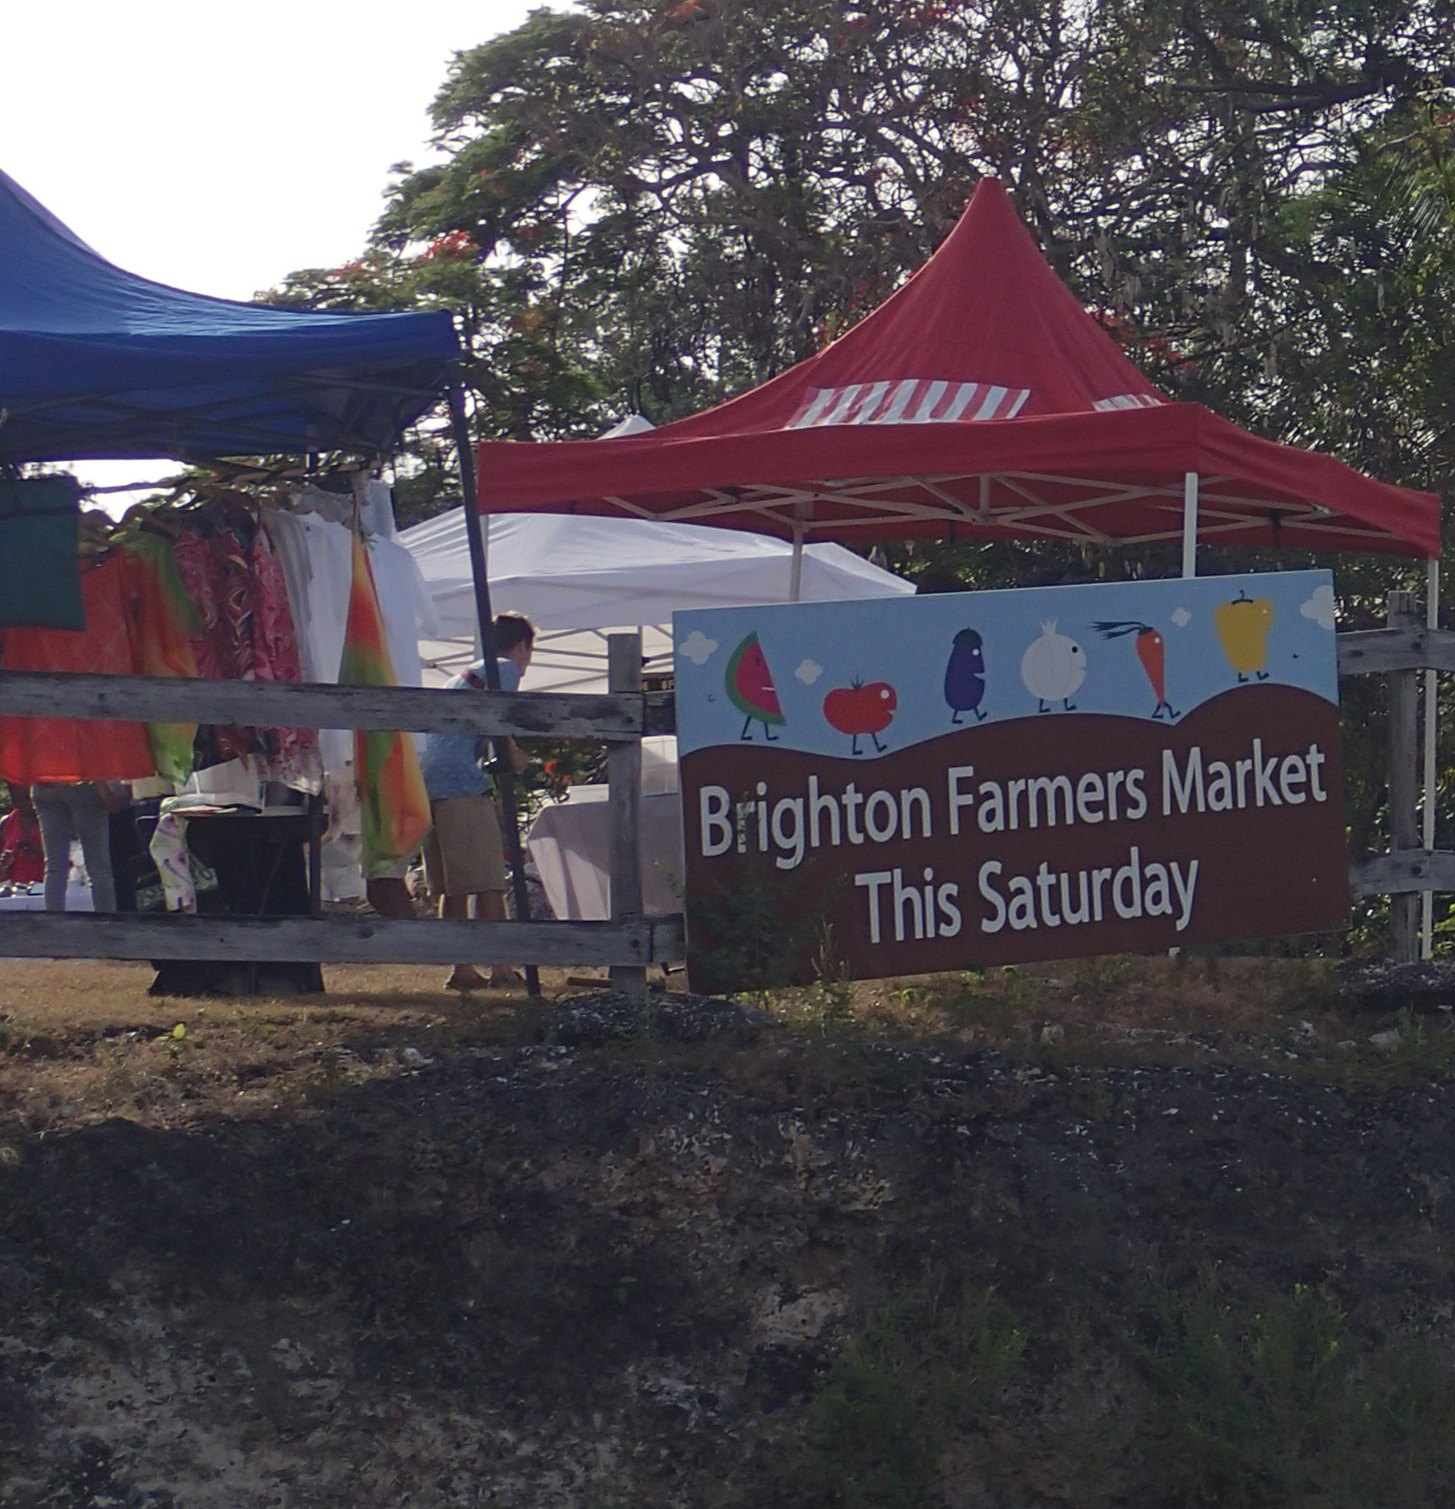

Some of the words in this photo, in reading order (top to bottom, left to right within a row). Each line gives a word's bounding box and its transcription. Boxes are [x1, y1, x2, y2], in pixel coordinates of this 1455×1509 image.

[699, 774, 933, 870] Brighton
[947, 765, 1148, 837] Farmers
[1161, 737, 1328, 817] Market
[853, 867, 962, 944] This
[977, 845, 1200, 932] Saturday
